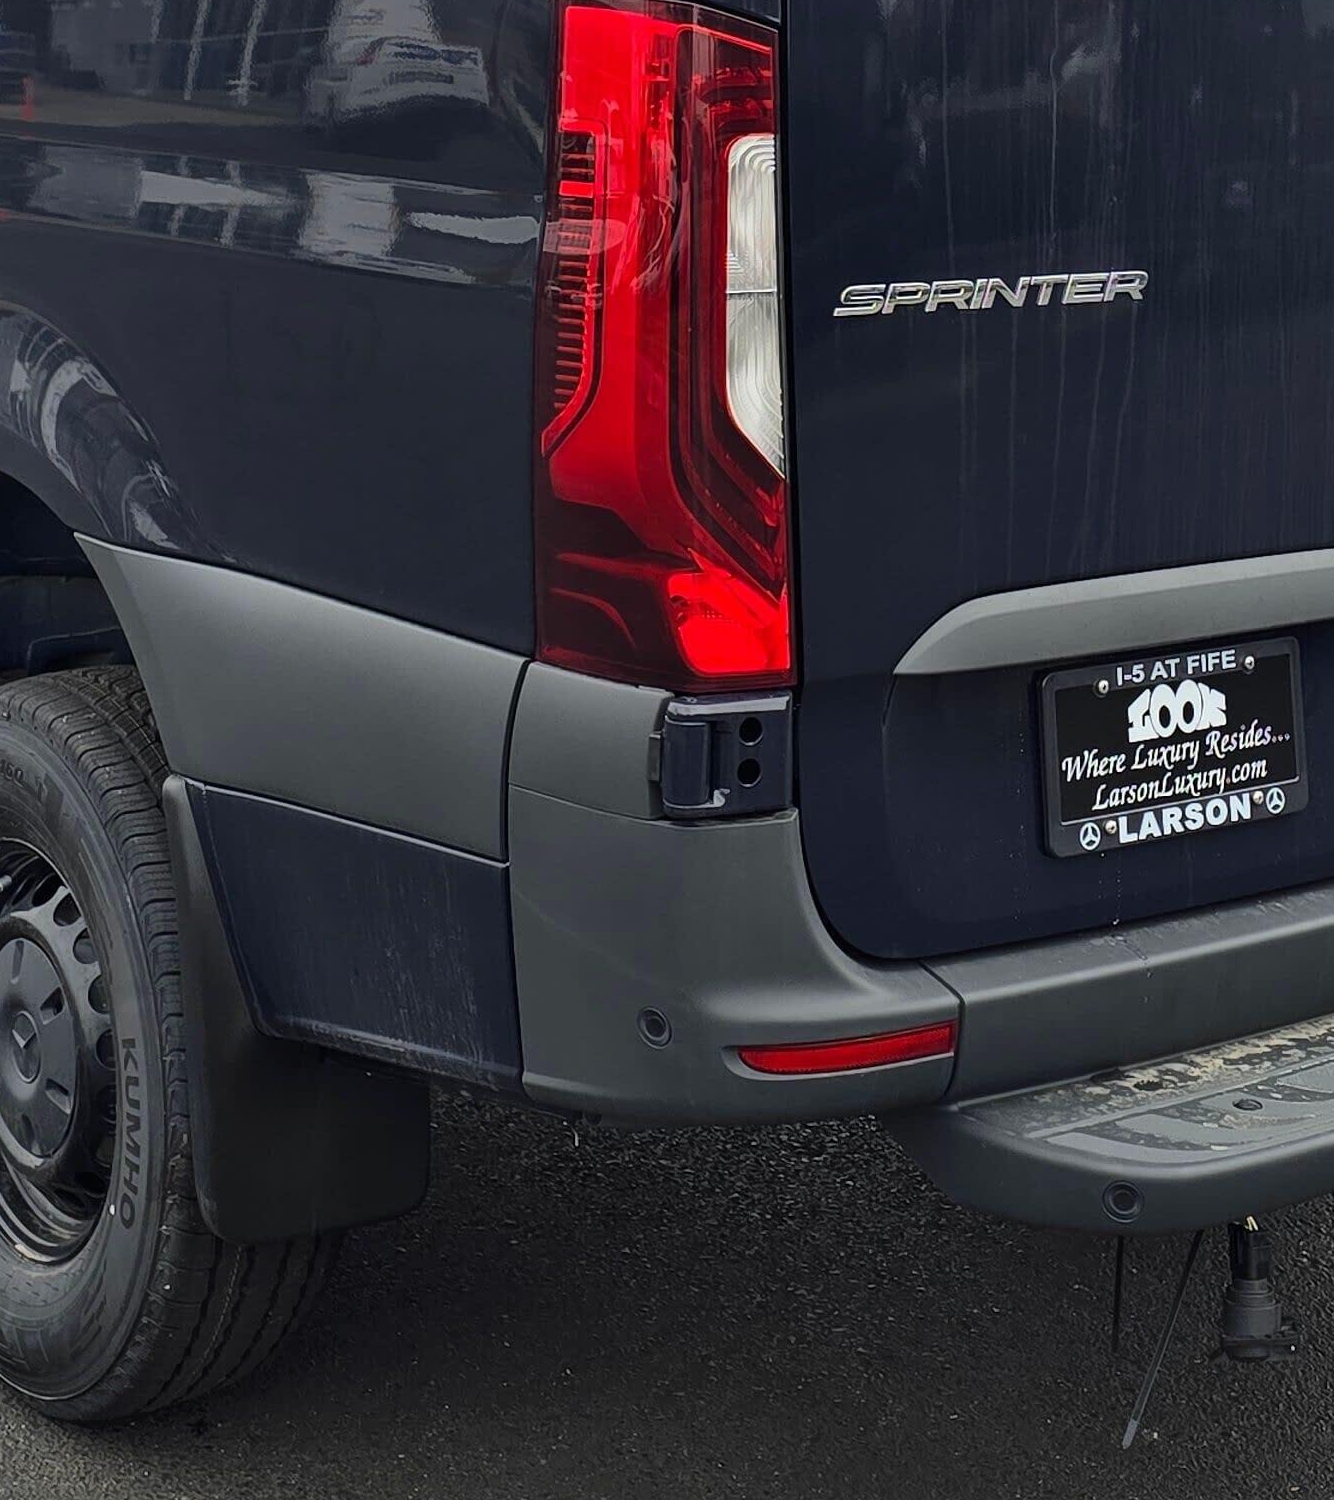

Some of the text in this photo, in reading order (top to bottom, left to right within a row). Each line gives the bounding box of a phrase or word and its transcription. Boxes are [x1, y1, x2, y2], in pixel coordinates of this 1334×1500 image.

[833, 269, 1149, 317] SPRINTER
[1117, 649, 1237, 687] I-5 AT FIFE
[1061, 718, 1291, 783] Where Luxury Resides...
[1091, 758, 1268, 812] LarsonLuxury.com
[1117, 793, 1252, 844] LARSON
[120, 1037, 141, 1230] KUMHO
